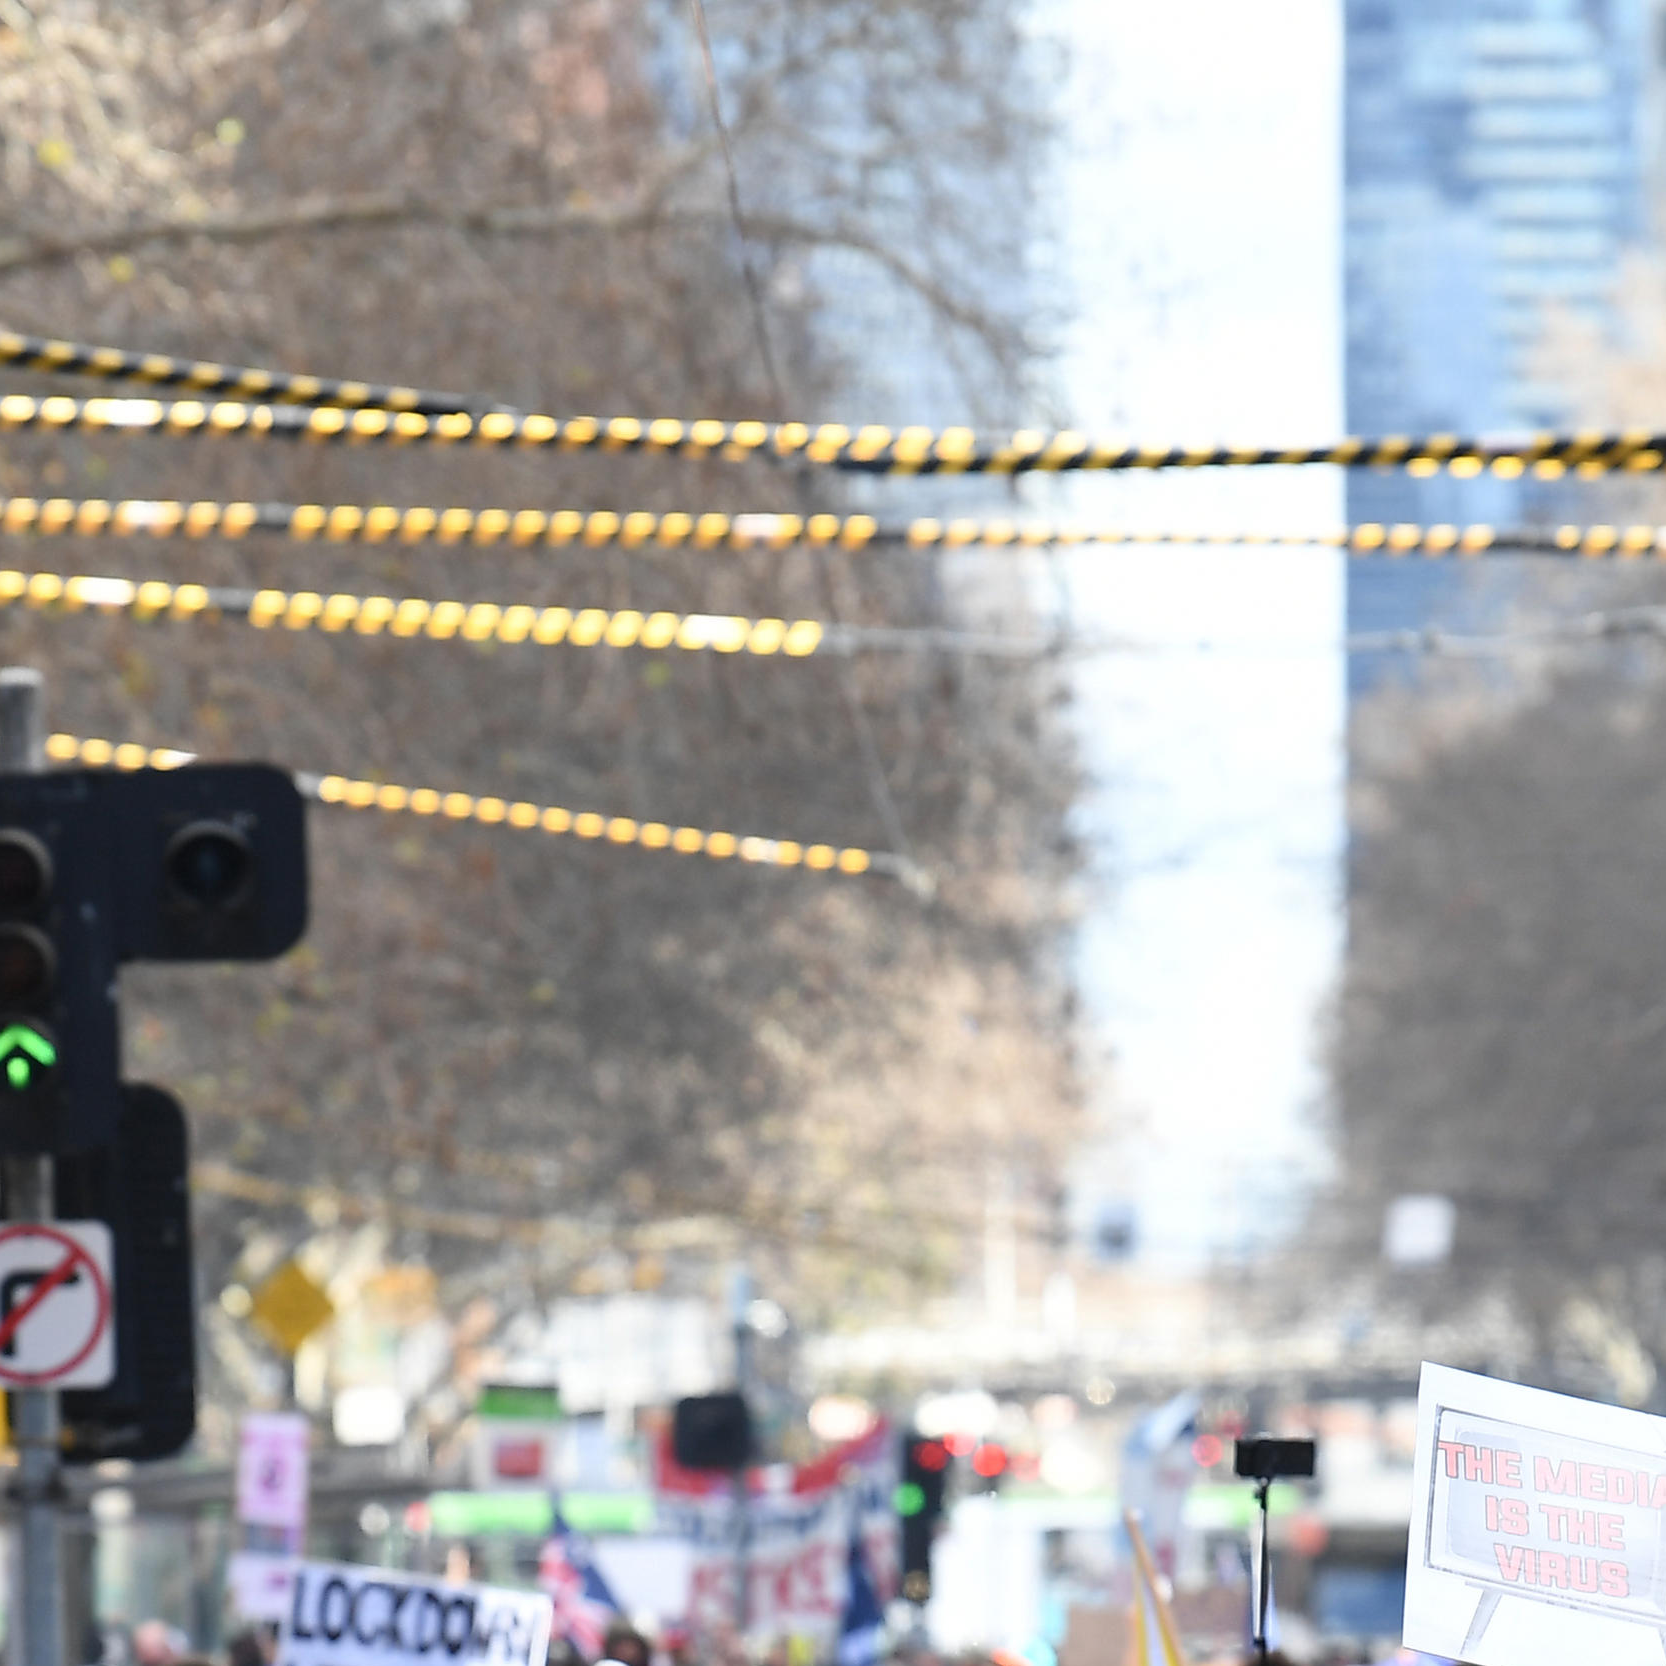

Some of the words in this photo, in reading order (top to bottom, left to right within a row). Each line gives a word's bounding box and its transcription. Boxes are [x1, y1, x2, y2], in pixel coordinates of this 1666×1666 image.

[1438, 1440, 1523, 1489] THE
[1485, 1495, 1529, 1536] IS
[1539, 1504, 1626, 1550] THE
[1493, 1543, 1629, 1598] VIRUS
